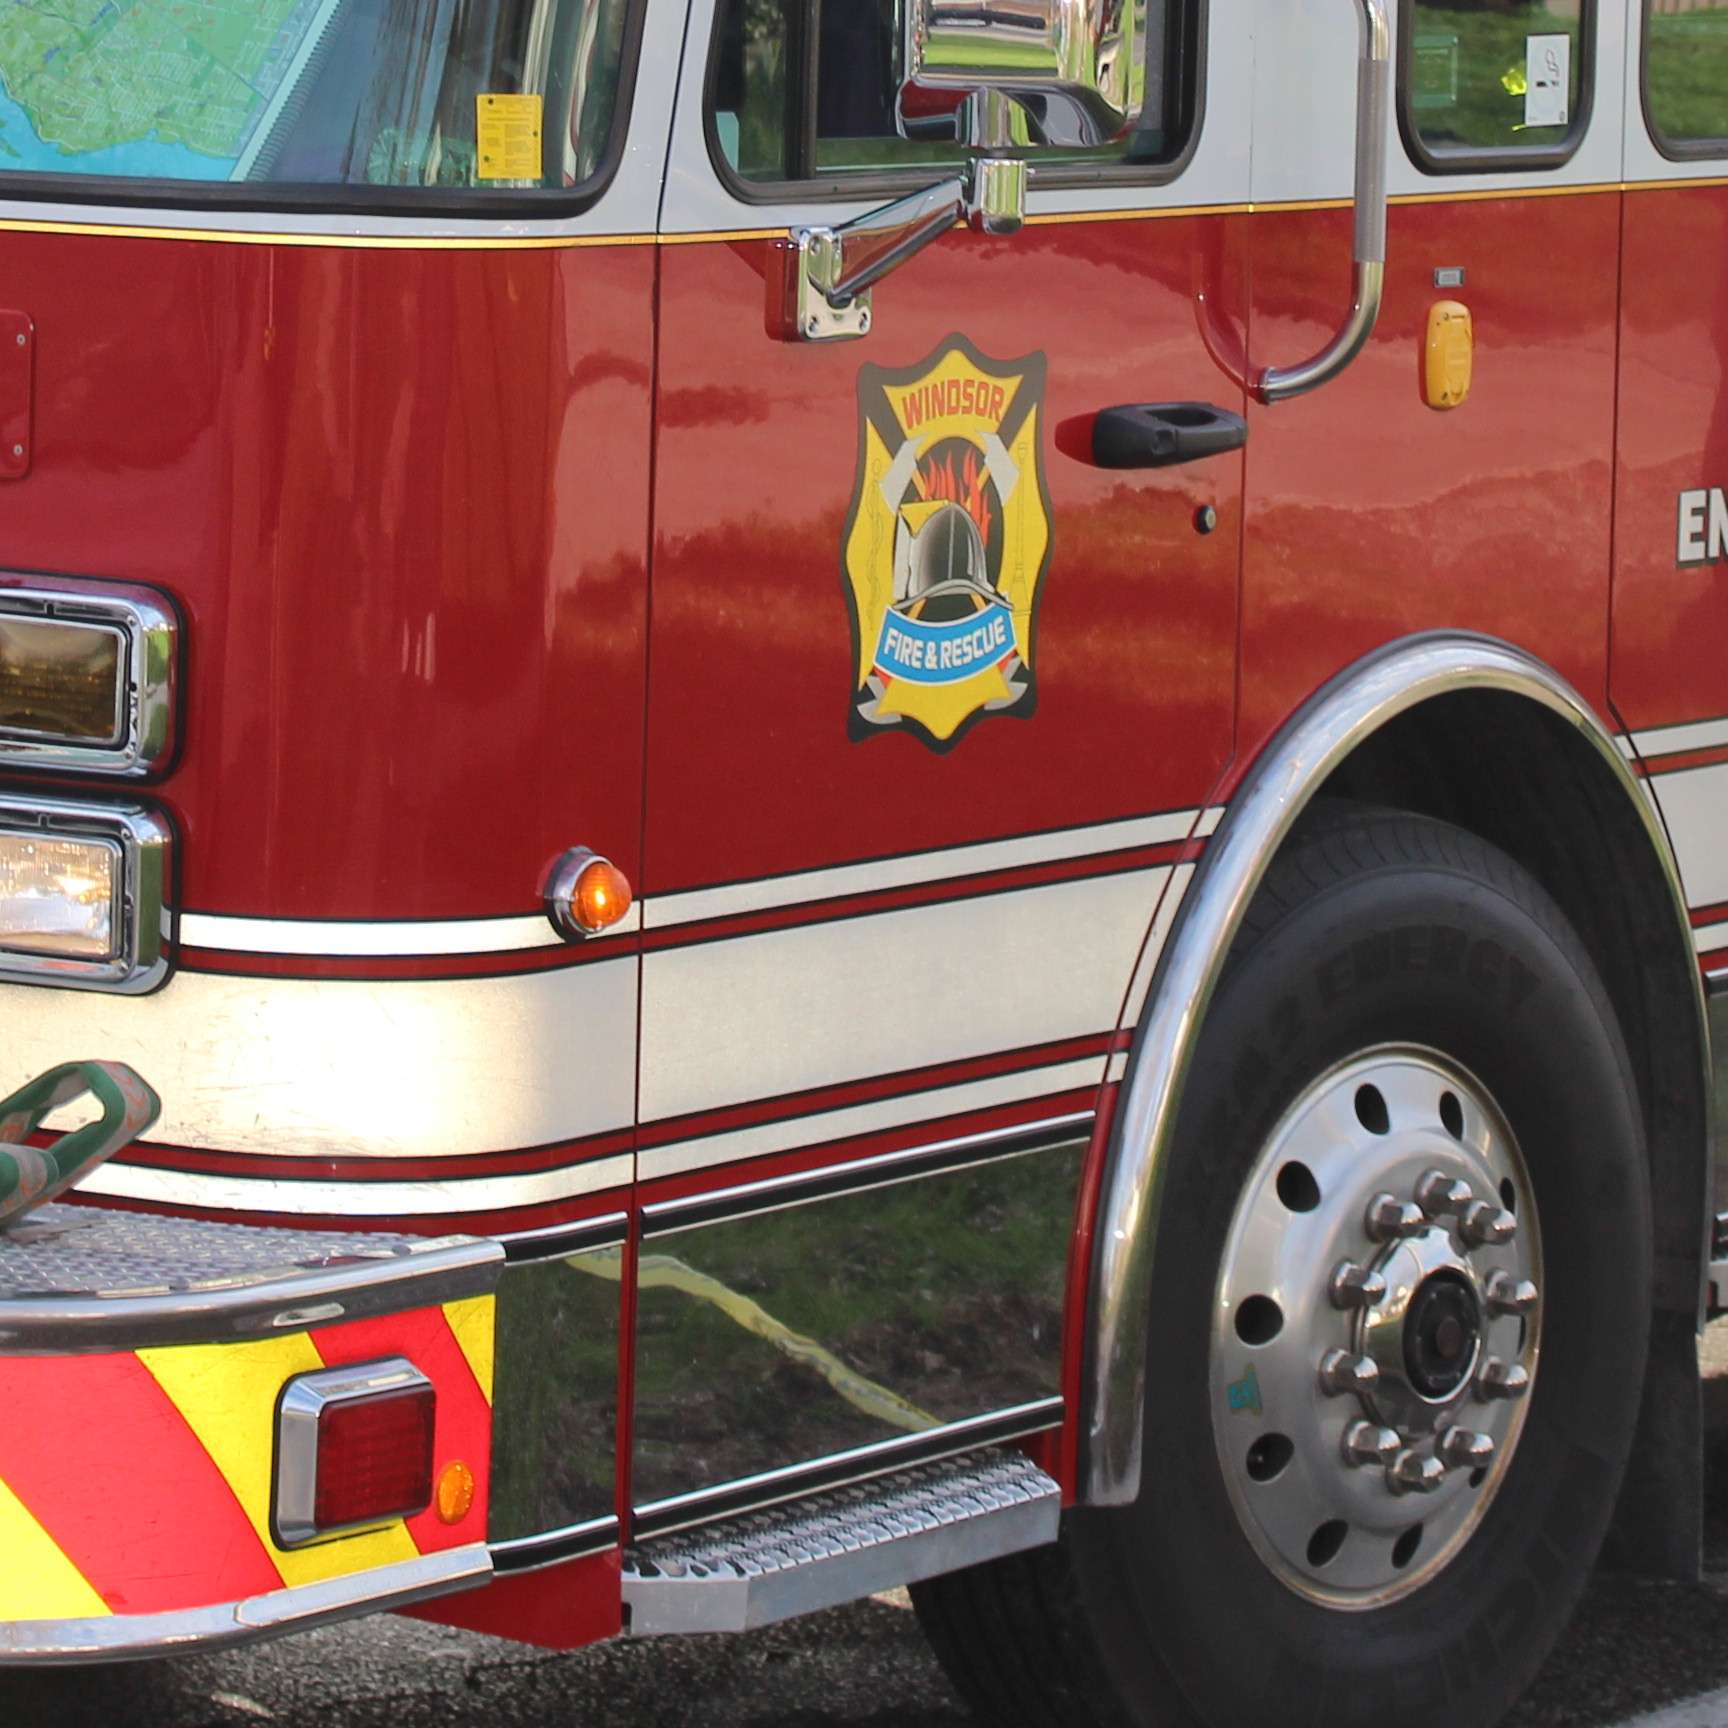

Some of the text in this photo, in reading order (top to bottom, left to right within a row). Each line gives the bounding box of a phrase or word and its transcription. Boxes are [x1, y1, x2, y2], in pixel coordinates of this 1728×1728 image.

[901, 379, 1005, 429] WINDSOR
[883, 615, 1007, 670] FIRE & RESCUE
